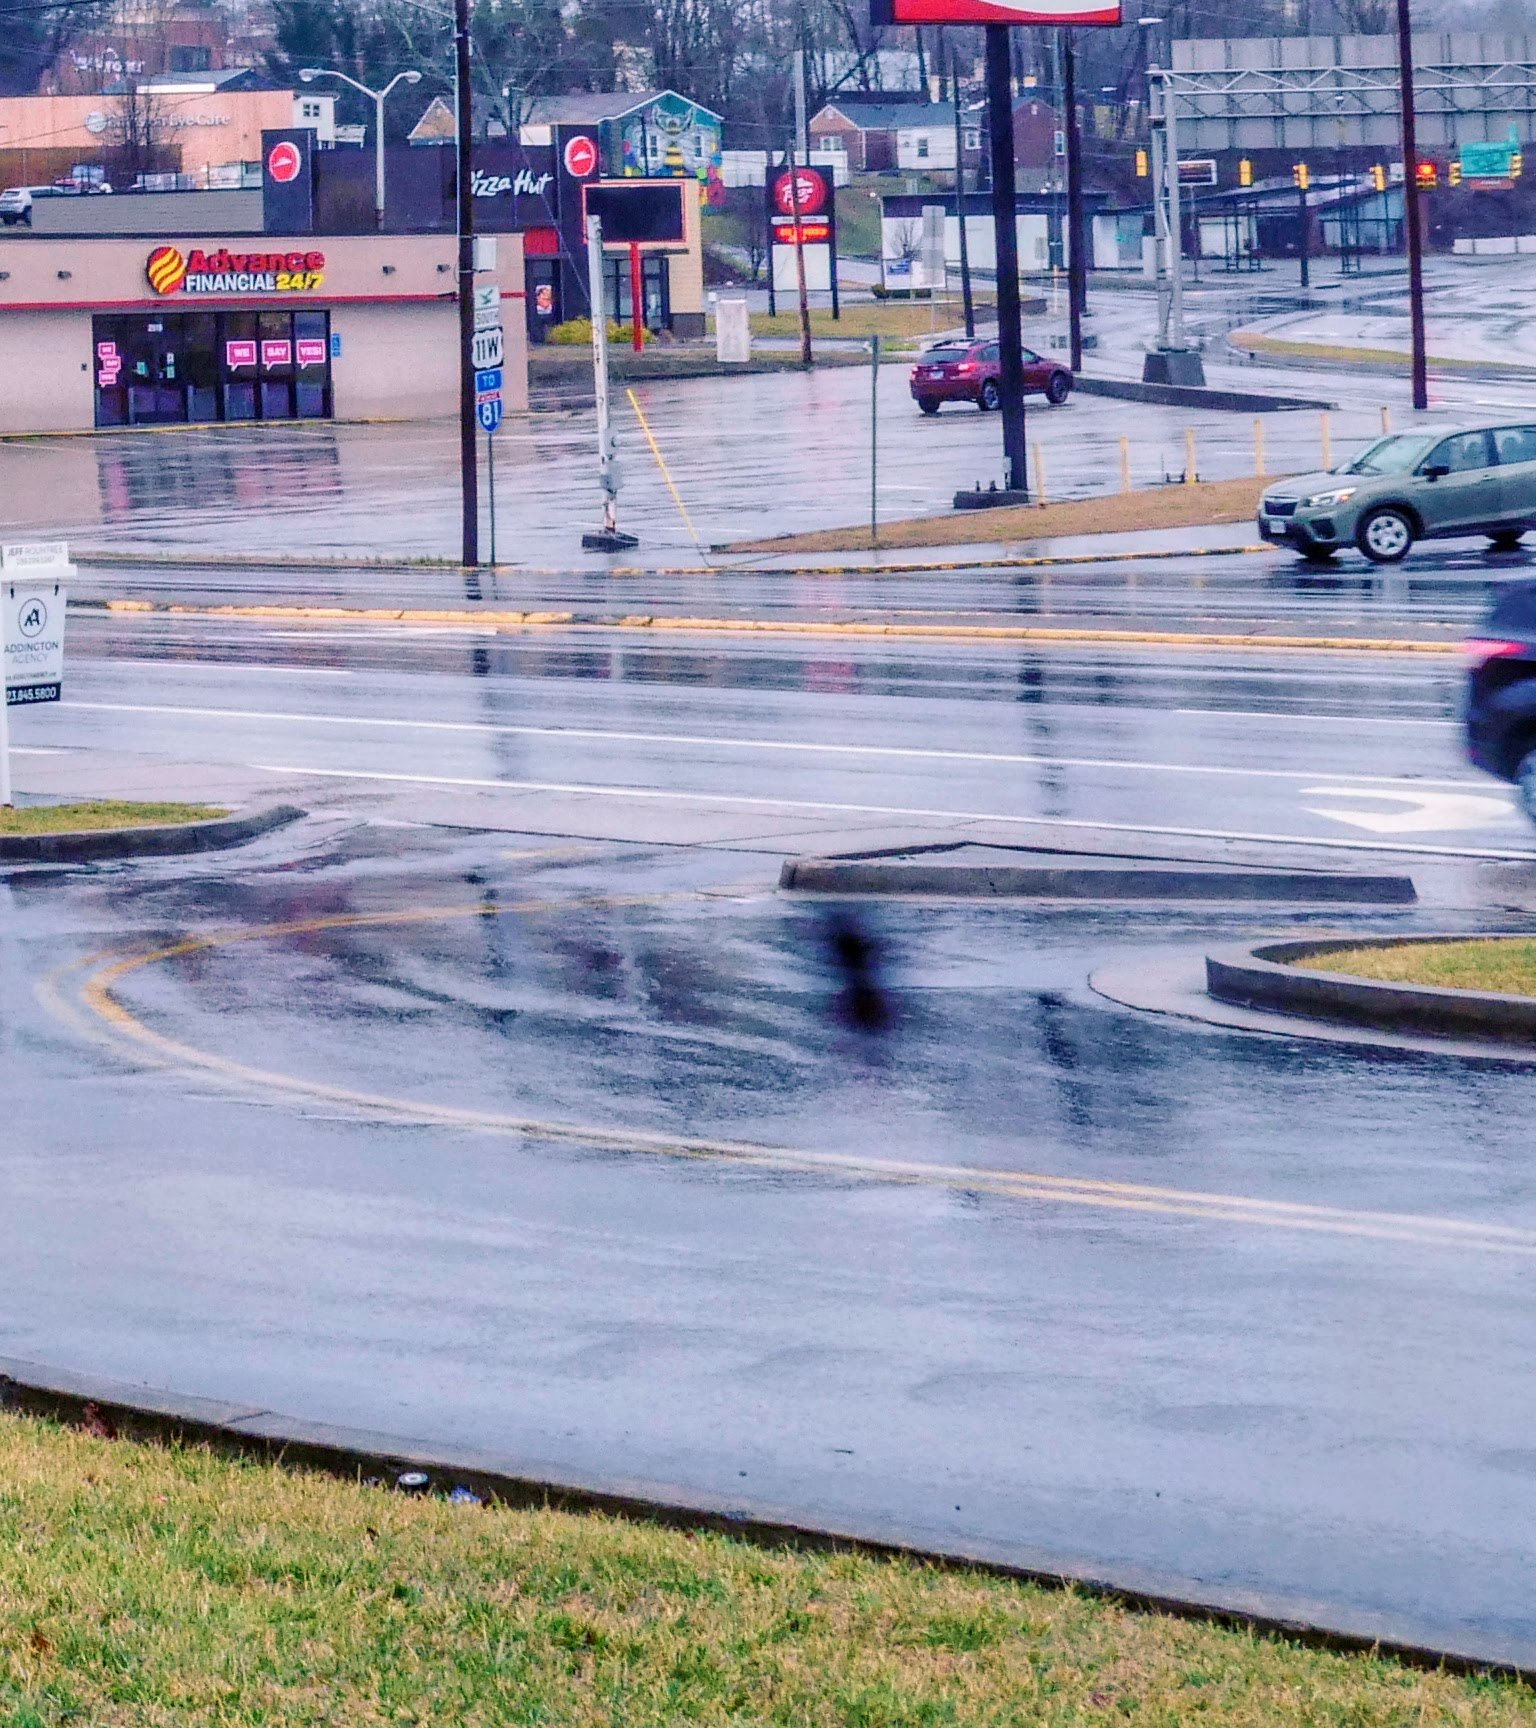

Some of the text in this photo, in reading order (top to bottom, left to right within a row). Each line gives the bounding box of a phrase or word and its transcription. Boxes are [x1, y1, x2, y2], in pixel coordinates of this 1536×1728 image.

[471, 168, 554, 197] izza Hut
[187, 249, 325, 272] Advance
[186, 273, 325, 292] FINANCIAL 24/7
[476, 335, 499, 362] 11W
[482, 374, 495, 387] TO
[482, 401, 499, 426] 81
[4, 640, 59, 654] ADDINGTON
